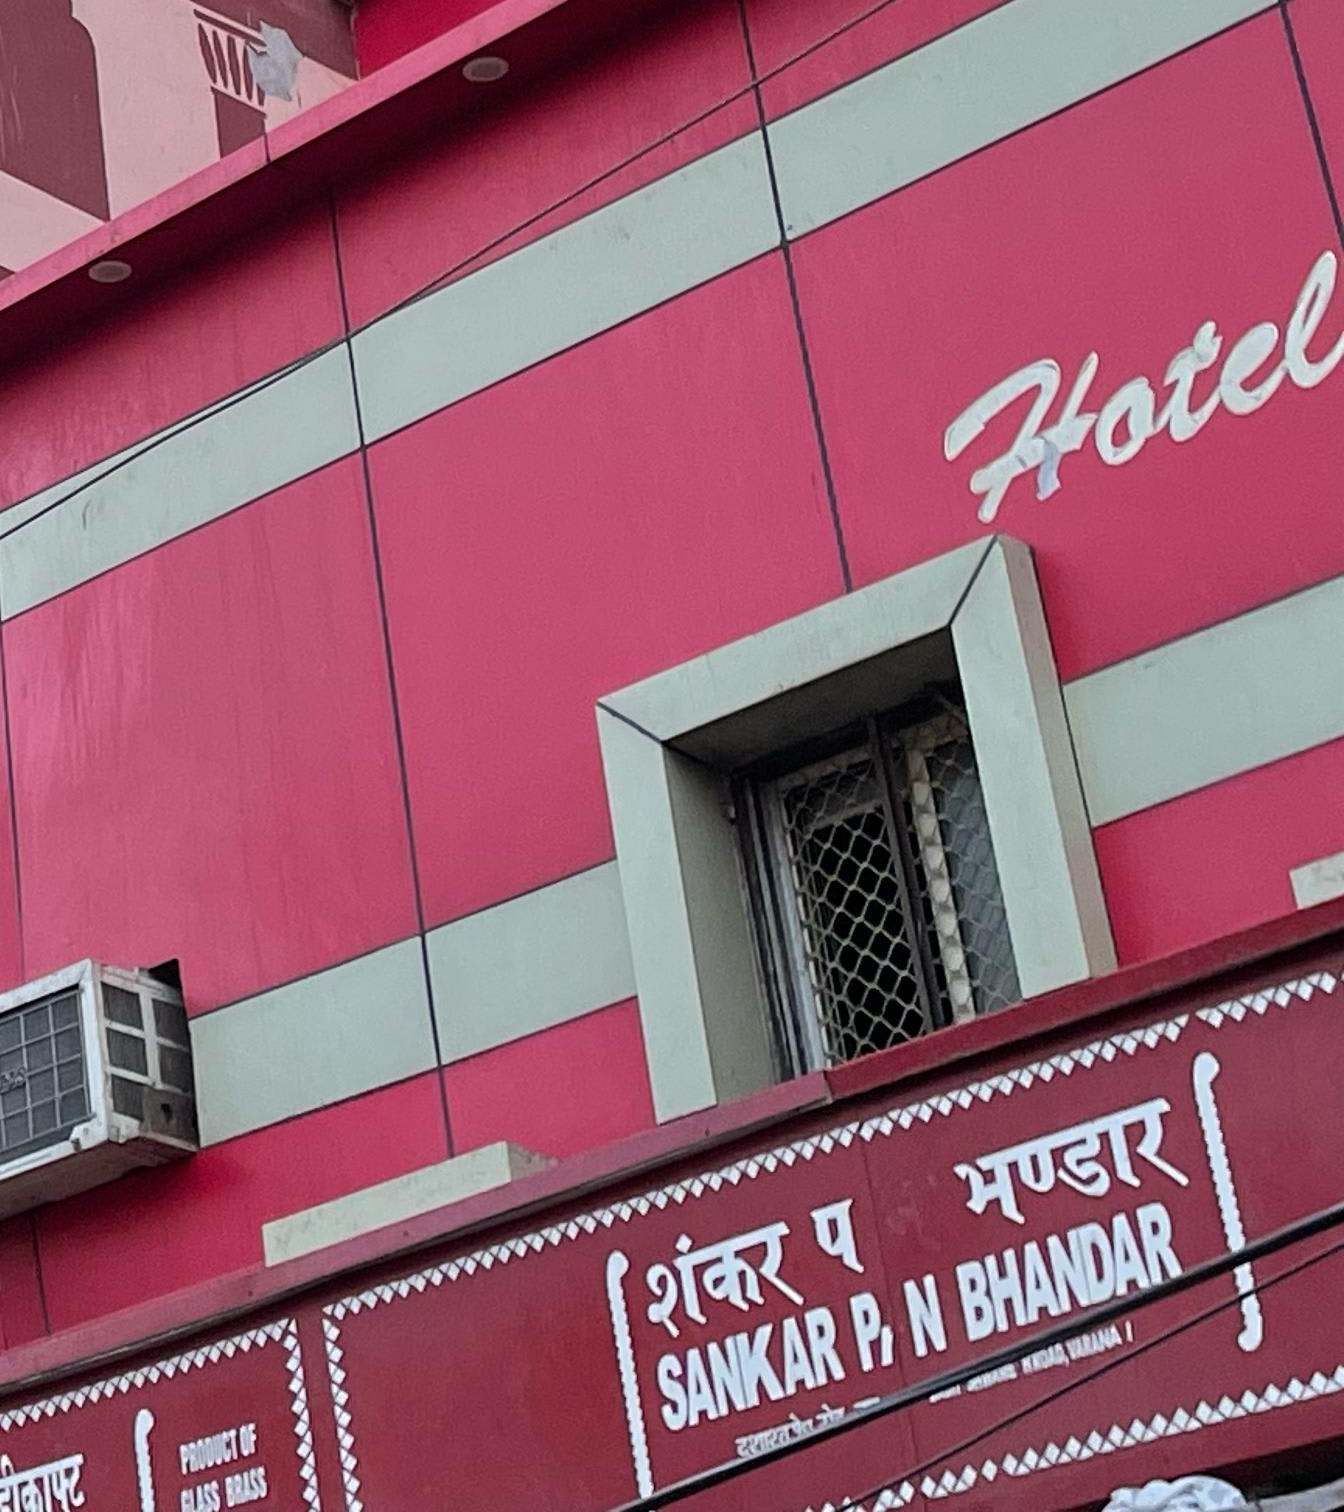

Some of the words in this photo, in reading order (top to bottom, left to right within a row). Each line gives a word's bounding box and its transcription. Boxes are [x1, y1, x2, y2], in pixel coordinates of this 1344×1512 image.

[943, 249, 1344, 524] Hotel
[645, 1220, 804, 1338] शंकर
[954, 1097, 1188, 1226] भण्डार
[656, 1307, 845, 1432] SANKAR
[954, 1201, 1184, 1343] BHANDAR
[179, 1428, 238, 1475] PRODUCT
[240, 1422, 257, 1456] OF
[224, 1465, 267, 1507] BRASS
